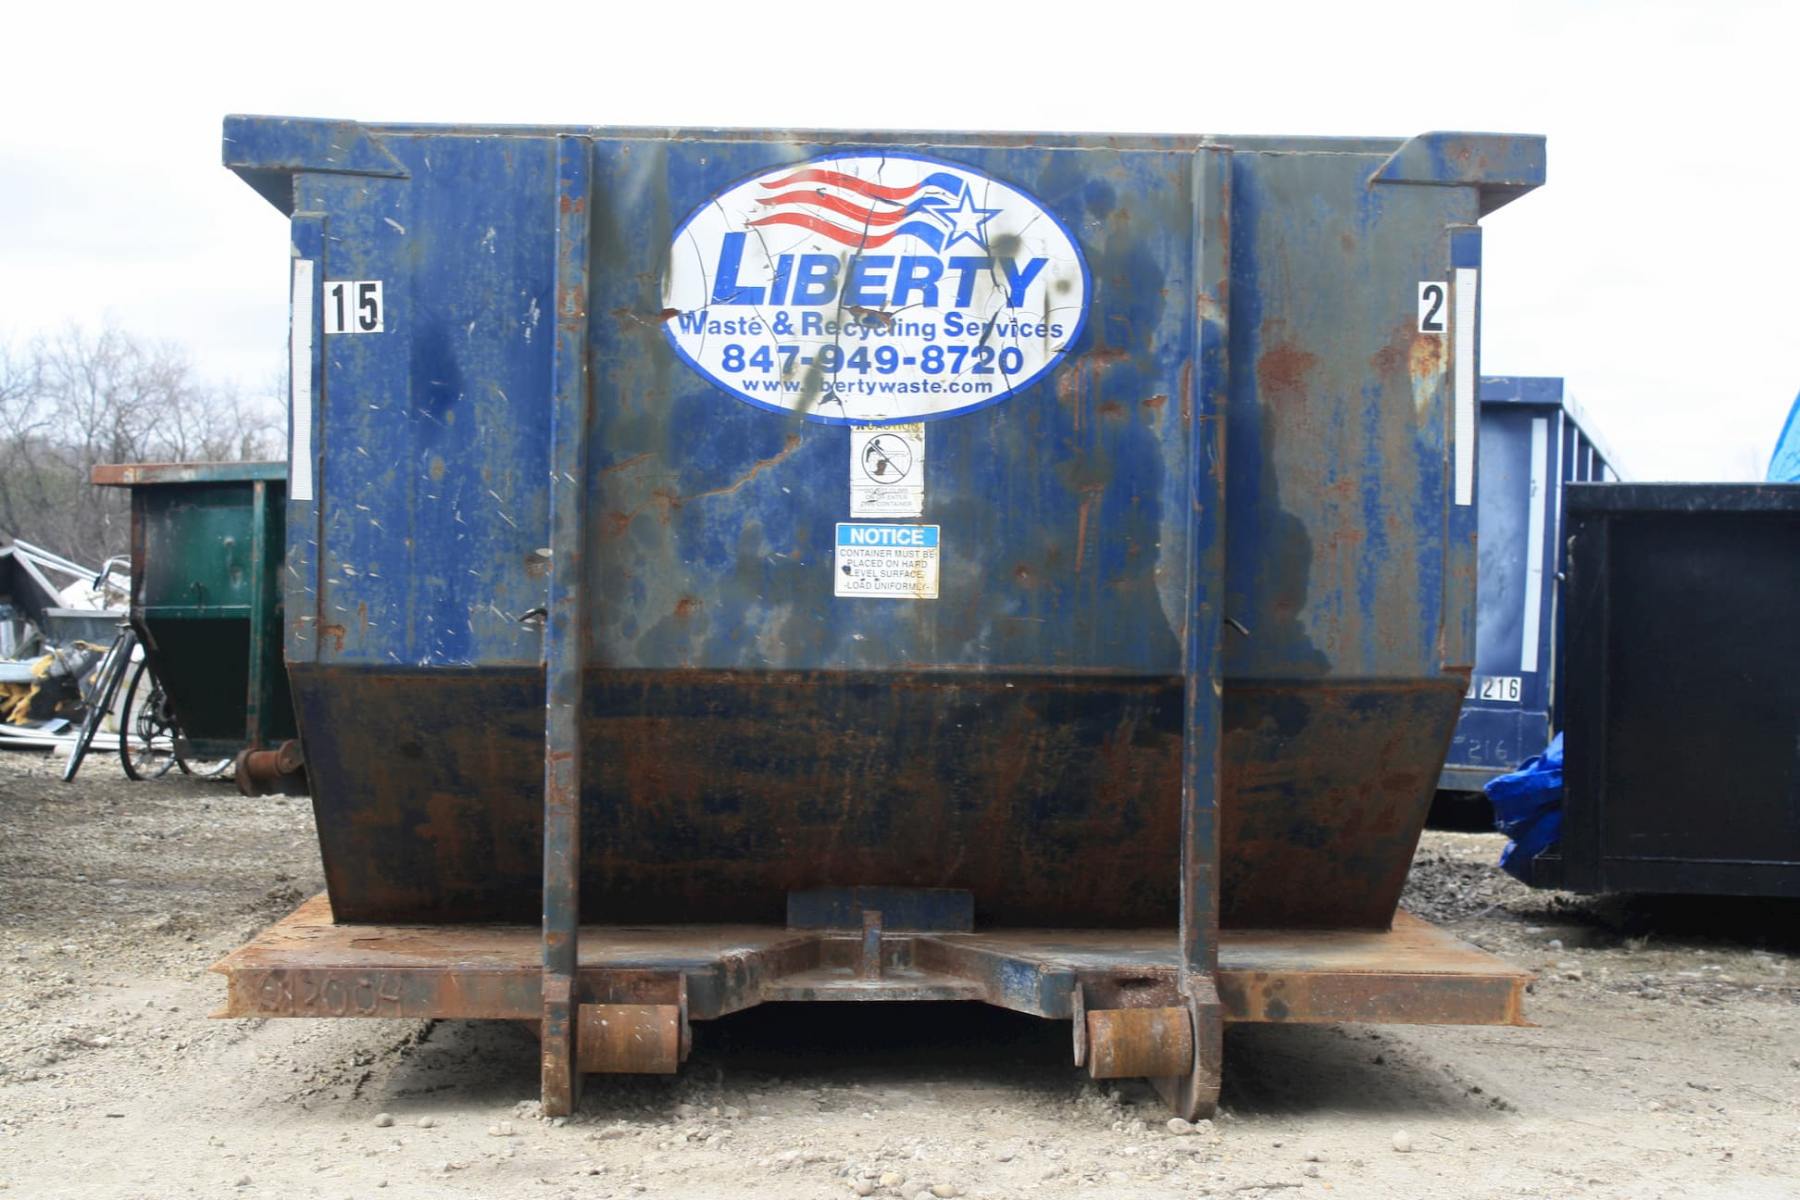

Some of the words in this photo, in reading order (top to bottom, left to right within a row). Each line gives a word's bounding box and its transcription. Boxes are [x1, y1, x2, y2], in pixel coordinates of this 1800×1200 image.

[710, 231, 1050, 309] LIBERTY
[332, 283, 378, 332] 15
[1421, 284, 1444, 331] 2
[678, 310, 763, 336] Waste
[772, 311, 796, 336] &
[943, 311, 1064, 339] Services
[721, 343, 1025, 376] 847-949-8720
[742, 378, 994, 396] www.bertywaste.com
[851, 528, 925, 546] NOTICE
[840, 549, 892, 558] CONTAINER
[894, 550, 920, 558] MUST
[847, 559, 883, 568] PLACED
[885, 560, 899, 568] ON
[901, 560, 929, 569] HARD
[1483, 678, 1519, 699] 216
